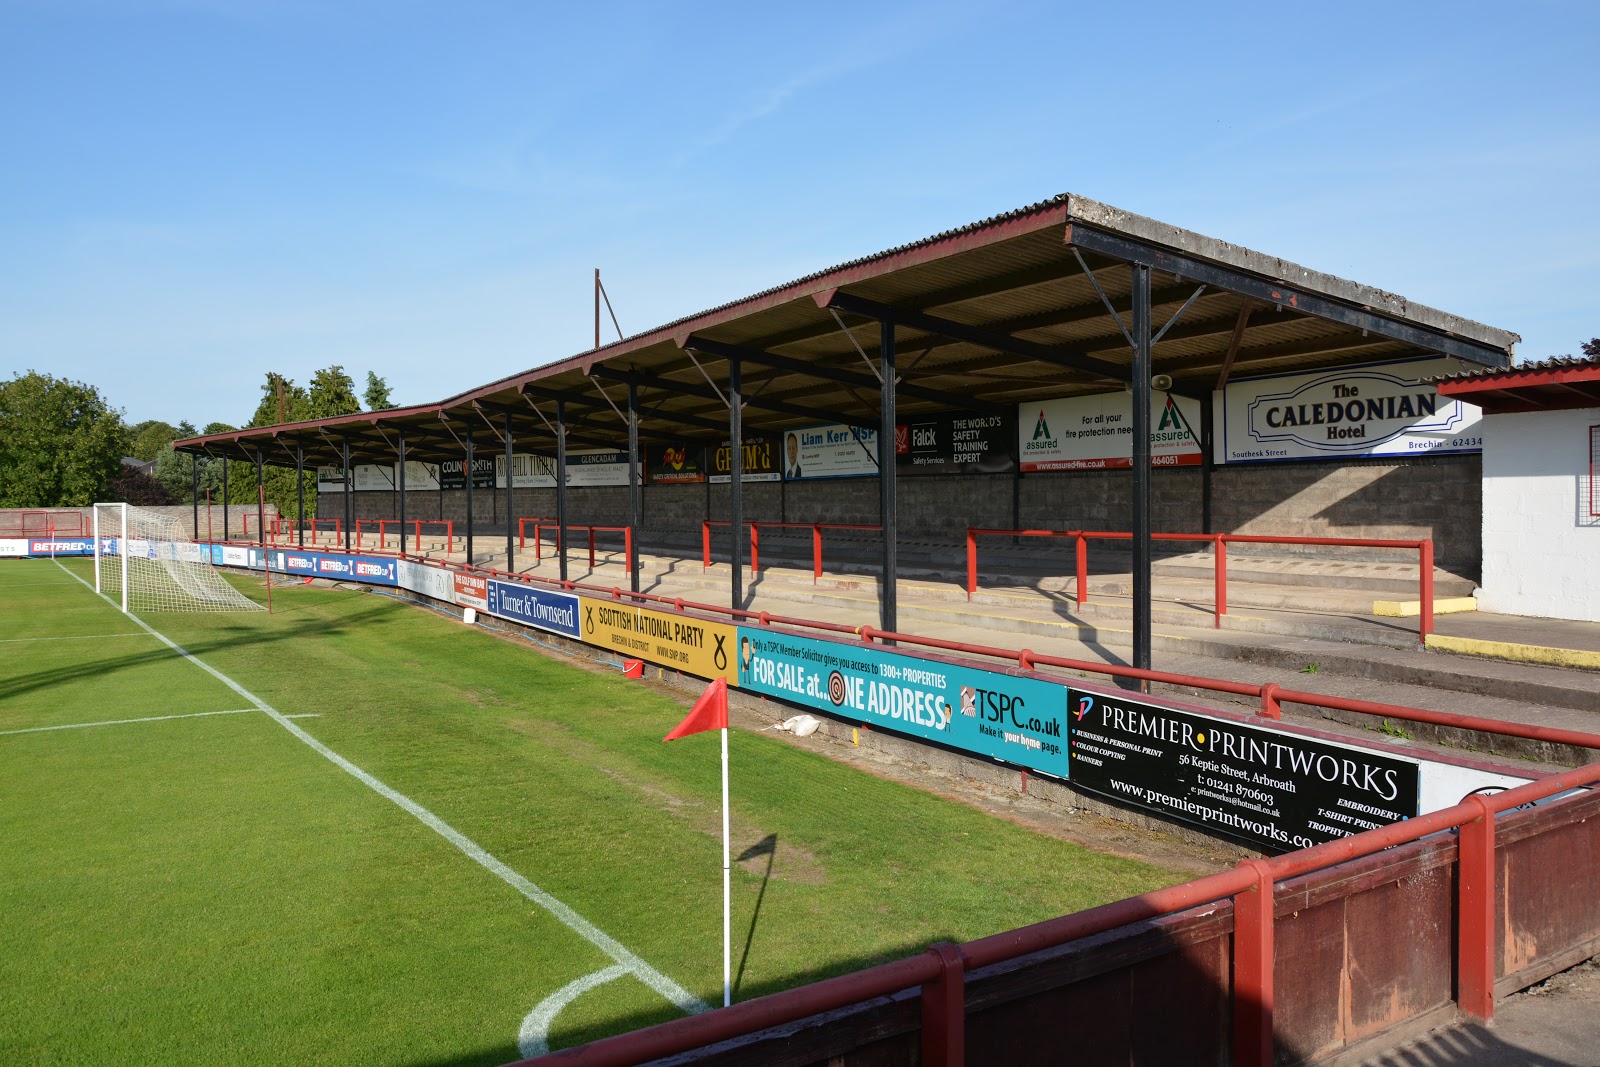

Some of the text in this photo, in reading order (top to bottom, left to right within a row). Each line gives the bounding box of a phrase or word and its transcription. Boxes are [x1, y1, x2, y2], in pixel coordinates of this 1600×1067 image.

[1332, 384, 1359, 399] The
[1266, 392, 1436, 428] CALEDONIAN
[952, 419, 967, 430] THE
[1082, 414, 1122, 425] For all your
[801, 433, 823, 446] Liam
[826, 430, 849, 444] Kerr
[912, 428, 937, 447] Falck
[952, 430, 981, 441] SAFETY
[1065, 426, 1134, 440] fire protection nee
[1150, 429, 1190, 442] assured
[1326, 424, 1366, 440] Hotel
[952, 441, 989, 452] TRAINING
[1026, 438, 1058, 450] assured
[1408, 440, 1442, 449] Brechin
[581, 454, 617, 464] GLENCADAM
[912, 456, 945, 466] Safety Services
[953, 452, 981, 463] EXPERT
[1151, 455, 1178, 465] 464051
[1232, 449, 1287, 459] Southesk Street
[442, 460, 463, 473] COLIN
[1036, 459, 1106, 471] www.assured-fire.co.uk
[33, 542, 86, 551] BETFRED
[288, 557, 307, 568] BETFRED
[321, 560, 342, 571] BETFRED
[357, 562, 382, 576] BETFRED
[461, 575, 470, 586] GOLF
[477, 578, 485, 590] BAR
[501, 590, 524, 616] Turner
[524, 594, 532, 617] &
[531, 597, 575, 629] Townsend
[598, 606, 704, 650] SCOTTISH NATIONAL PARTY
[611, 633, 627, 647] BRECHIN
[631, 638, 649, 652] DISTRICT
[752, 638, 764, 653] Only
[767, 641, 780, 654] TSPC
[780, 644, 801, 658] Member
[801, 647, 824, 662] Solicitor
[824, 652, 839, 667] gives
[838, 657, 850, 670] you
[850, 661, 870, 674] access
[871, 663, 879, 675] to
[879, 663, 902, 679] 1300+
[902, 667, 947, 689] PROPERTIES
[753, 656, 776, 687] FOR
[776, 661, 805, 694] SALE
[868, 680, 947, 731] ADDRESS
[975, 688, 1061, 738] TSPC.co.uk
[979, 723, 1062, 756] Make it your home page.
[1076, 729, 1104, 743] BUSINESS
[1109, 738, 1142, 753] PERSONAL
[1142, 747, 1163, 760] PRINT
[1076, 741, 1127, 761] COLOUR COPYING
[1102, 704, 1398, 801] PREMIER PRINTWORKS
[1076, 753, 1104, 767] BANNERS
[1178, 754, 1297, 794] 56 Keptie Street, Arbroath
[1190, 785, 1197, 793] e:
[1197, 773, 1275, 807] t: 01241 870603
[1110, 778, 1333, 850] www.premierprintworks.co
[1317, 807, 1354, 825] T-SHIRT
[1336, 797, 1402, 821] EMBROIDERY
[1307, 820, 1345, 838] TROPHY
